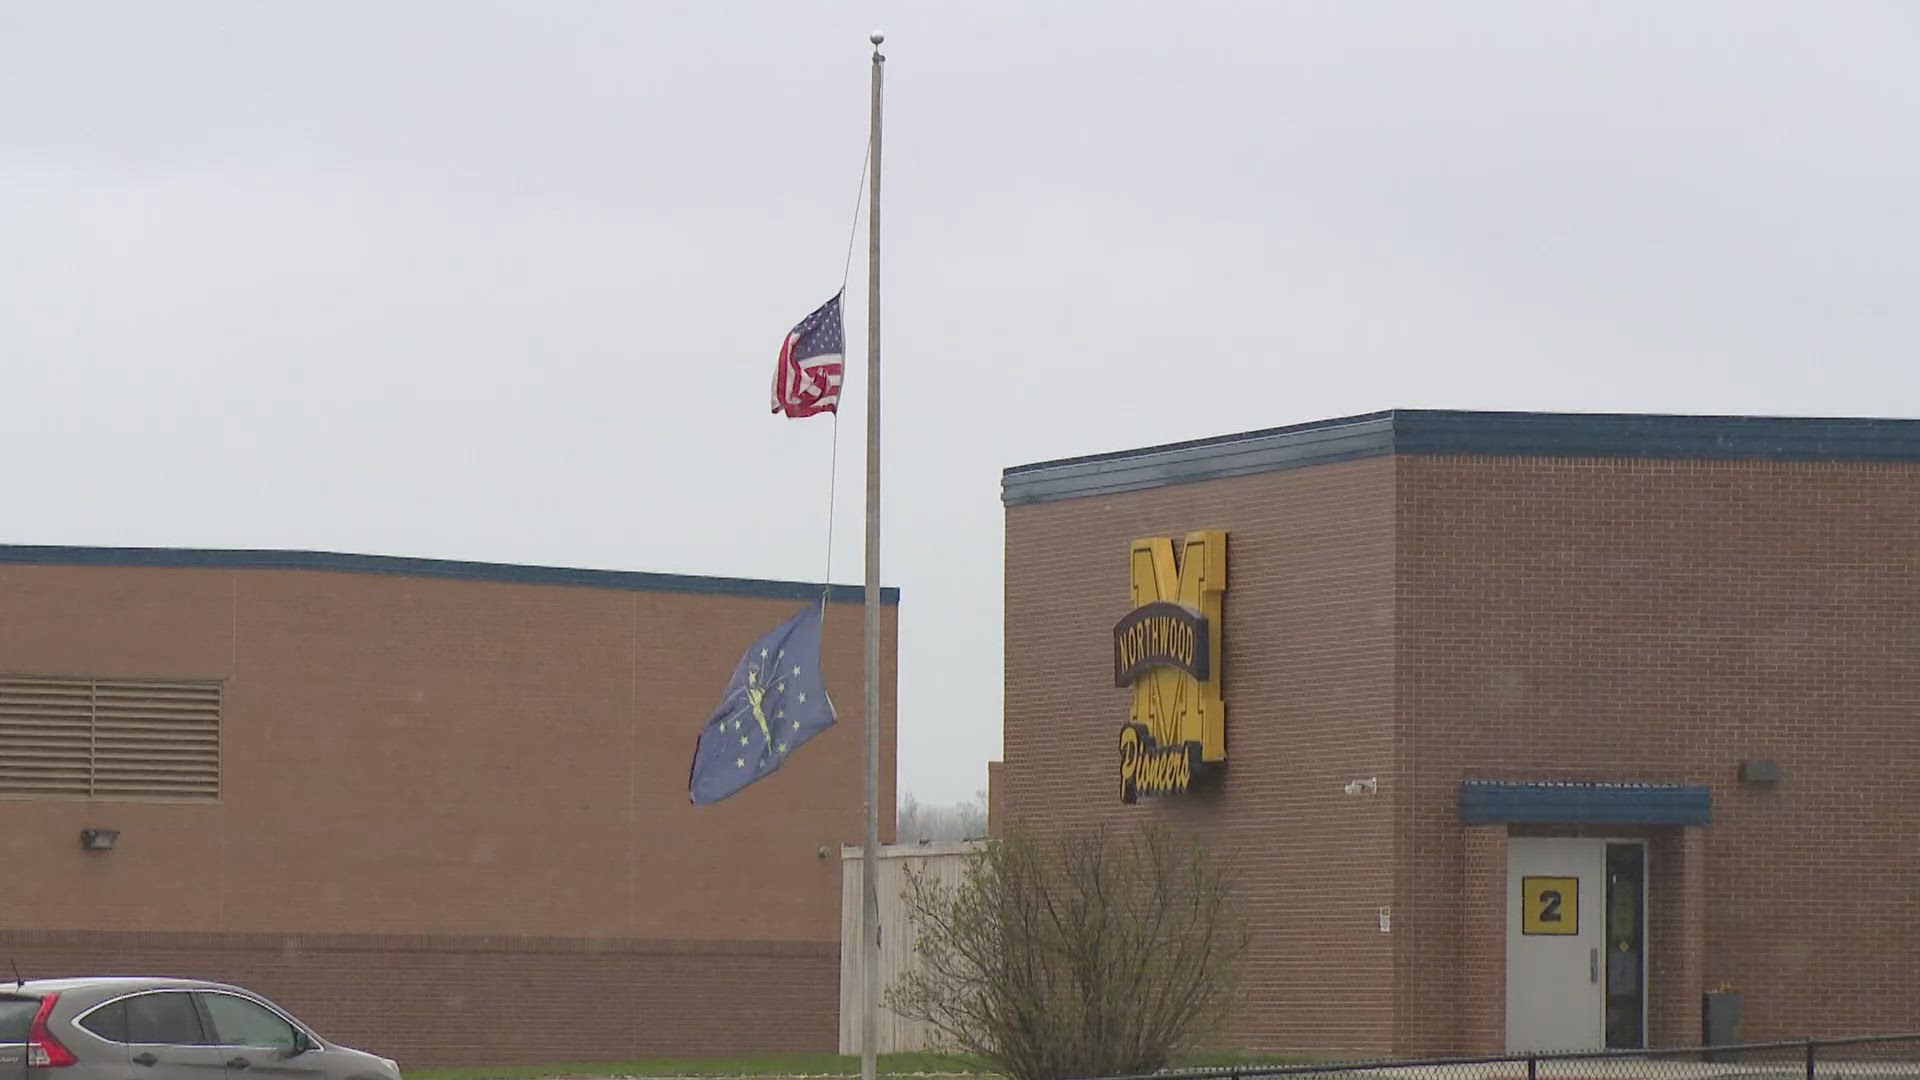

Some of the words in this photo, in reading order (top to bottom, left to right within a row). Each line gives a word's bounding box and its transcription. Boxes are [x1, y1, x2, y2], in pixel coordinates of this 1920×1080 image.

[1120, 616, 1194, 675] NORTHWOOD
[1120, 727, 1191, 801] Pioneers
[1540, 890, 1561, 922] 2
